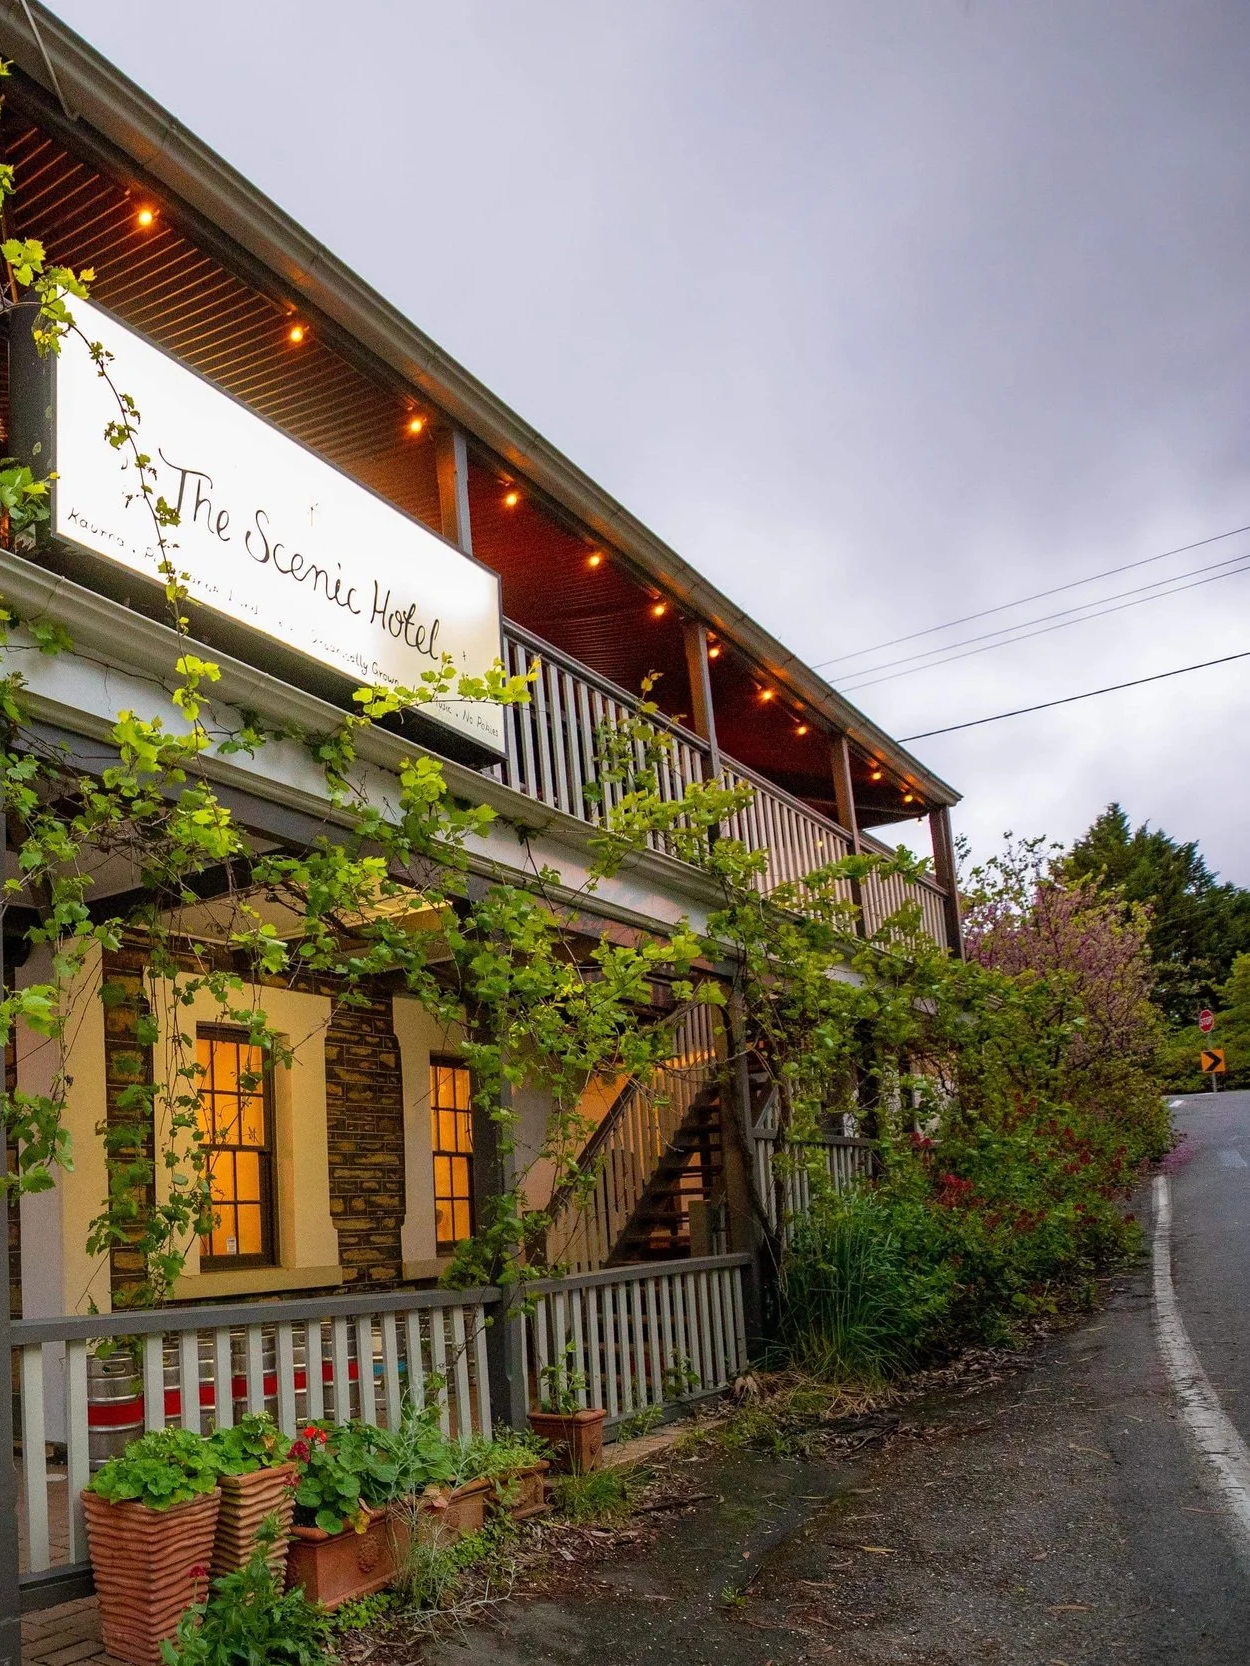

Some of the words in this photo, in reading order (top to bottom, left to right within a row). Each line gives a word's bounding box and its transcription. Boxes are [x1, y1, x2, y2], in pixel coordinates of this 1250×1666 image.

[67, 507, 125, 547] Kaurna
[371, 661, 400, 686] Grown
[462, 709, 474, 725] No
[158, 447, 231, 542] The
[245, 509, 361, 615] Scenic
[370, 579, 440, 661] Hotel
[1200, 1016, 1212, 1027] STOP
